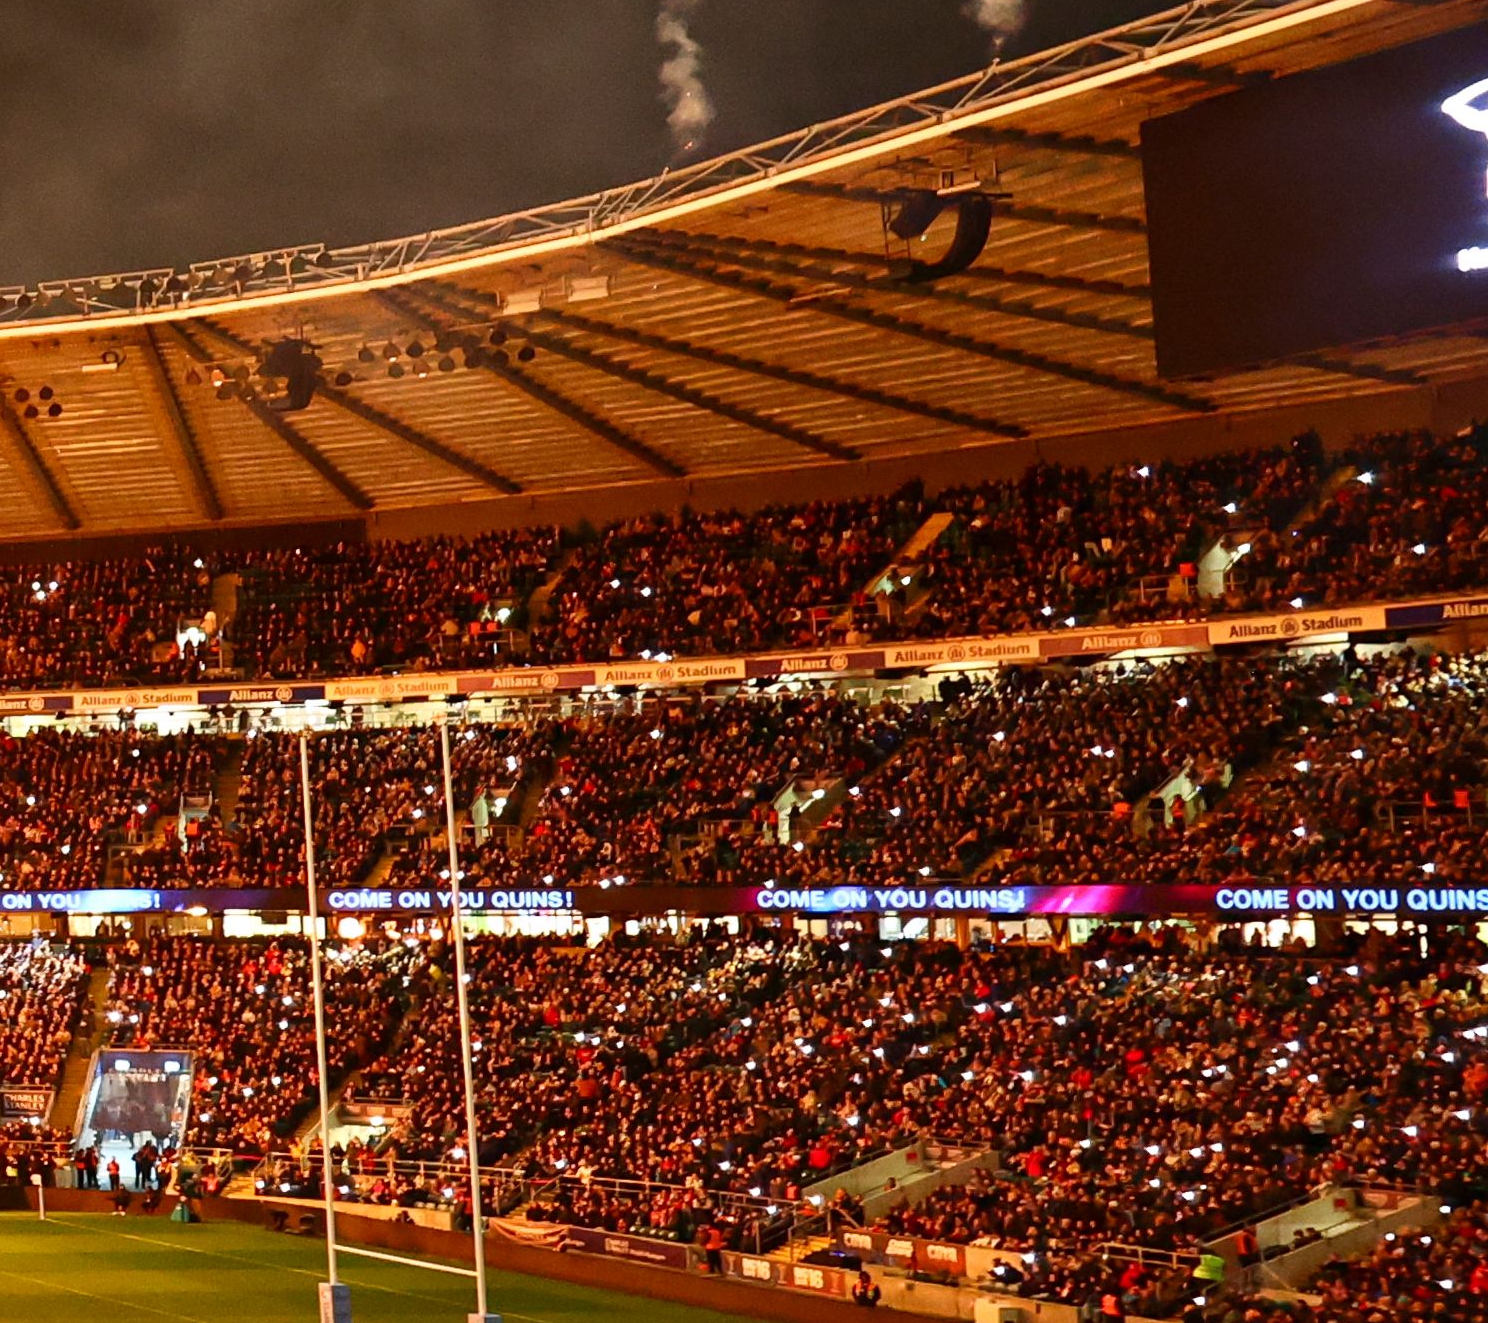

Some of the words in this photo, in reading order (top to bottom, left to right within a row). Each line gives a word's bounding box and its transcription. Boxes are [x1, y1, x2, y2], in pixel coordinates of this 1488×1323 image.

[1442, 603, 1488, 619] Allian
[1229, 619, 1277, 638] Allianz
[1302, 614, 1362, 631] Stadium
[1082, 633, 1136, 650] Allianz
[894, 647, 944, 662] Allianz
[968, 641, 1029, 658] Stadium
[780, 655, 826, 671] Allianz
[492, 674, 538, 688] Allianz
[605, 667, 652, 682] Allianz
[677, 663, 736, 678] Stadium
[229, 688, 273, 701] Allianz
[334, 683, 375, 696] Allianz
[397, 679, 449, 693] Stadium
[81, 694, 123, 706] Allianz
[142, 692, 192, 704] Stadium
[2, 894, 31, 910] ON
[35, 893, 80, 909] YOU
[329, 891, 391, 909] COME
[398, 891, 430, 909] ON
[437, 891, 484, 909] YOU
[491, 891, 572, 909] QUINS!
[757, 890, 824, 908] COME
[833, 890, 867, 908] ON
[874, 889, 926, 907] YOU
[934, 890, 1025, 910] QUINS!
[1216, 889, 1289, 909] COME
[1297, 889, 1334, 909] ON
[1342, 889, 1399, 909] YOU
[1407, 888, 1488, 911] QUINS
